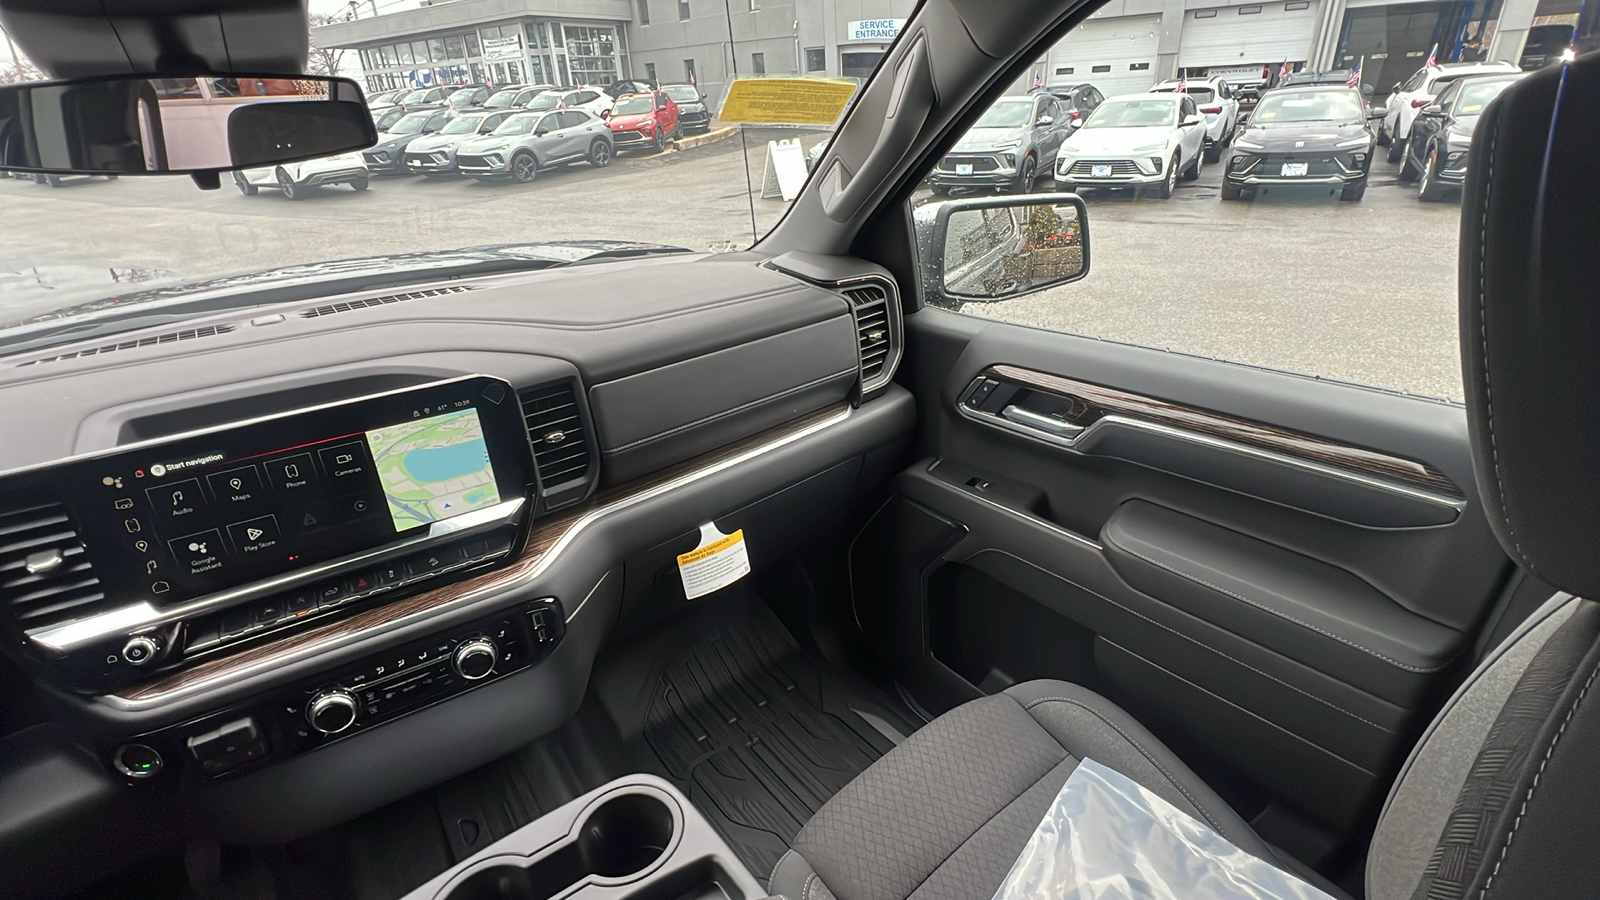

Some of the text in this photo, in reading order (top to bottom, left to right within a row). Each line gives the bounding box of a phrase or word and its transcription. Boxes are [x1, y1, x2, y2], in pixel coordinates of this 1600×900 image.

[859, 20, 894, 29] SERVICE
[855, 29, 899, 38] ENTRANCE
[454, 399, 470, 408] 10:39
[166, 454, 223, 471] Start navigation
[334, 466, 362, 477] Cameras
[285, 480, 307, 488] Phone
[231, 492, 251, 502] Maps
[172, 506, 193, 516] Audio
[244, 540, 276, 553] Play Store
[191, 555, 216, 567] Google
[191, 562, 222, 574] Assistant
